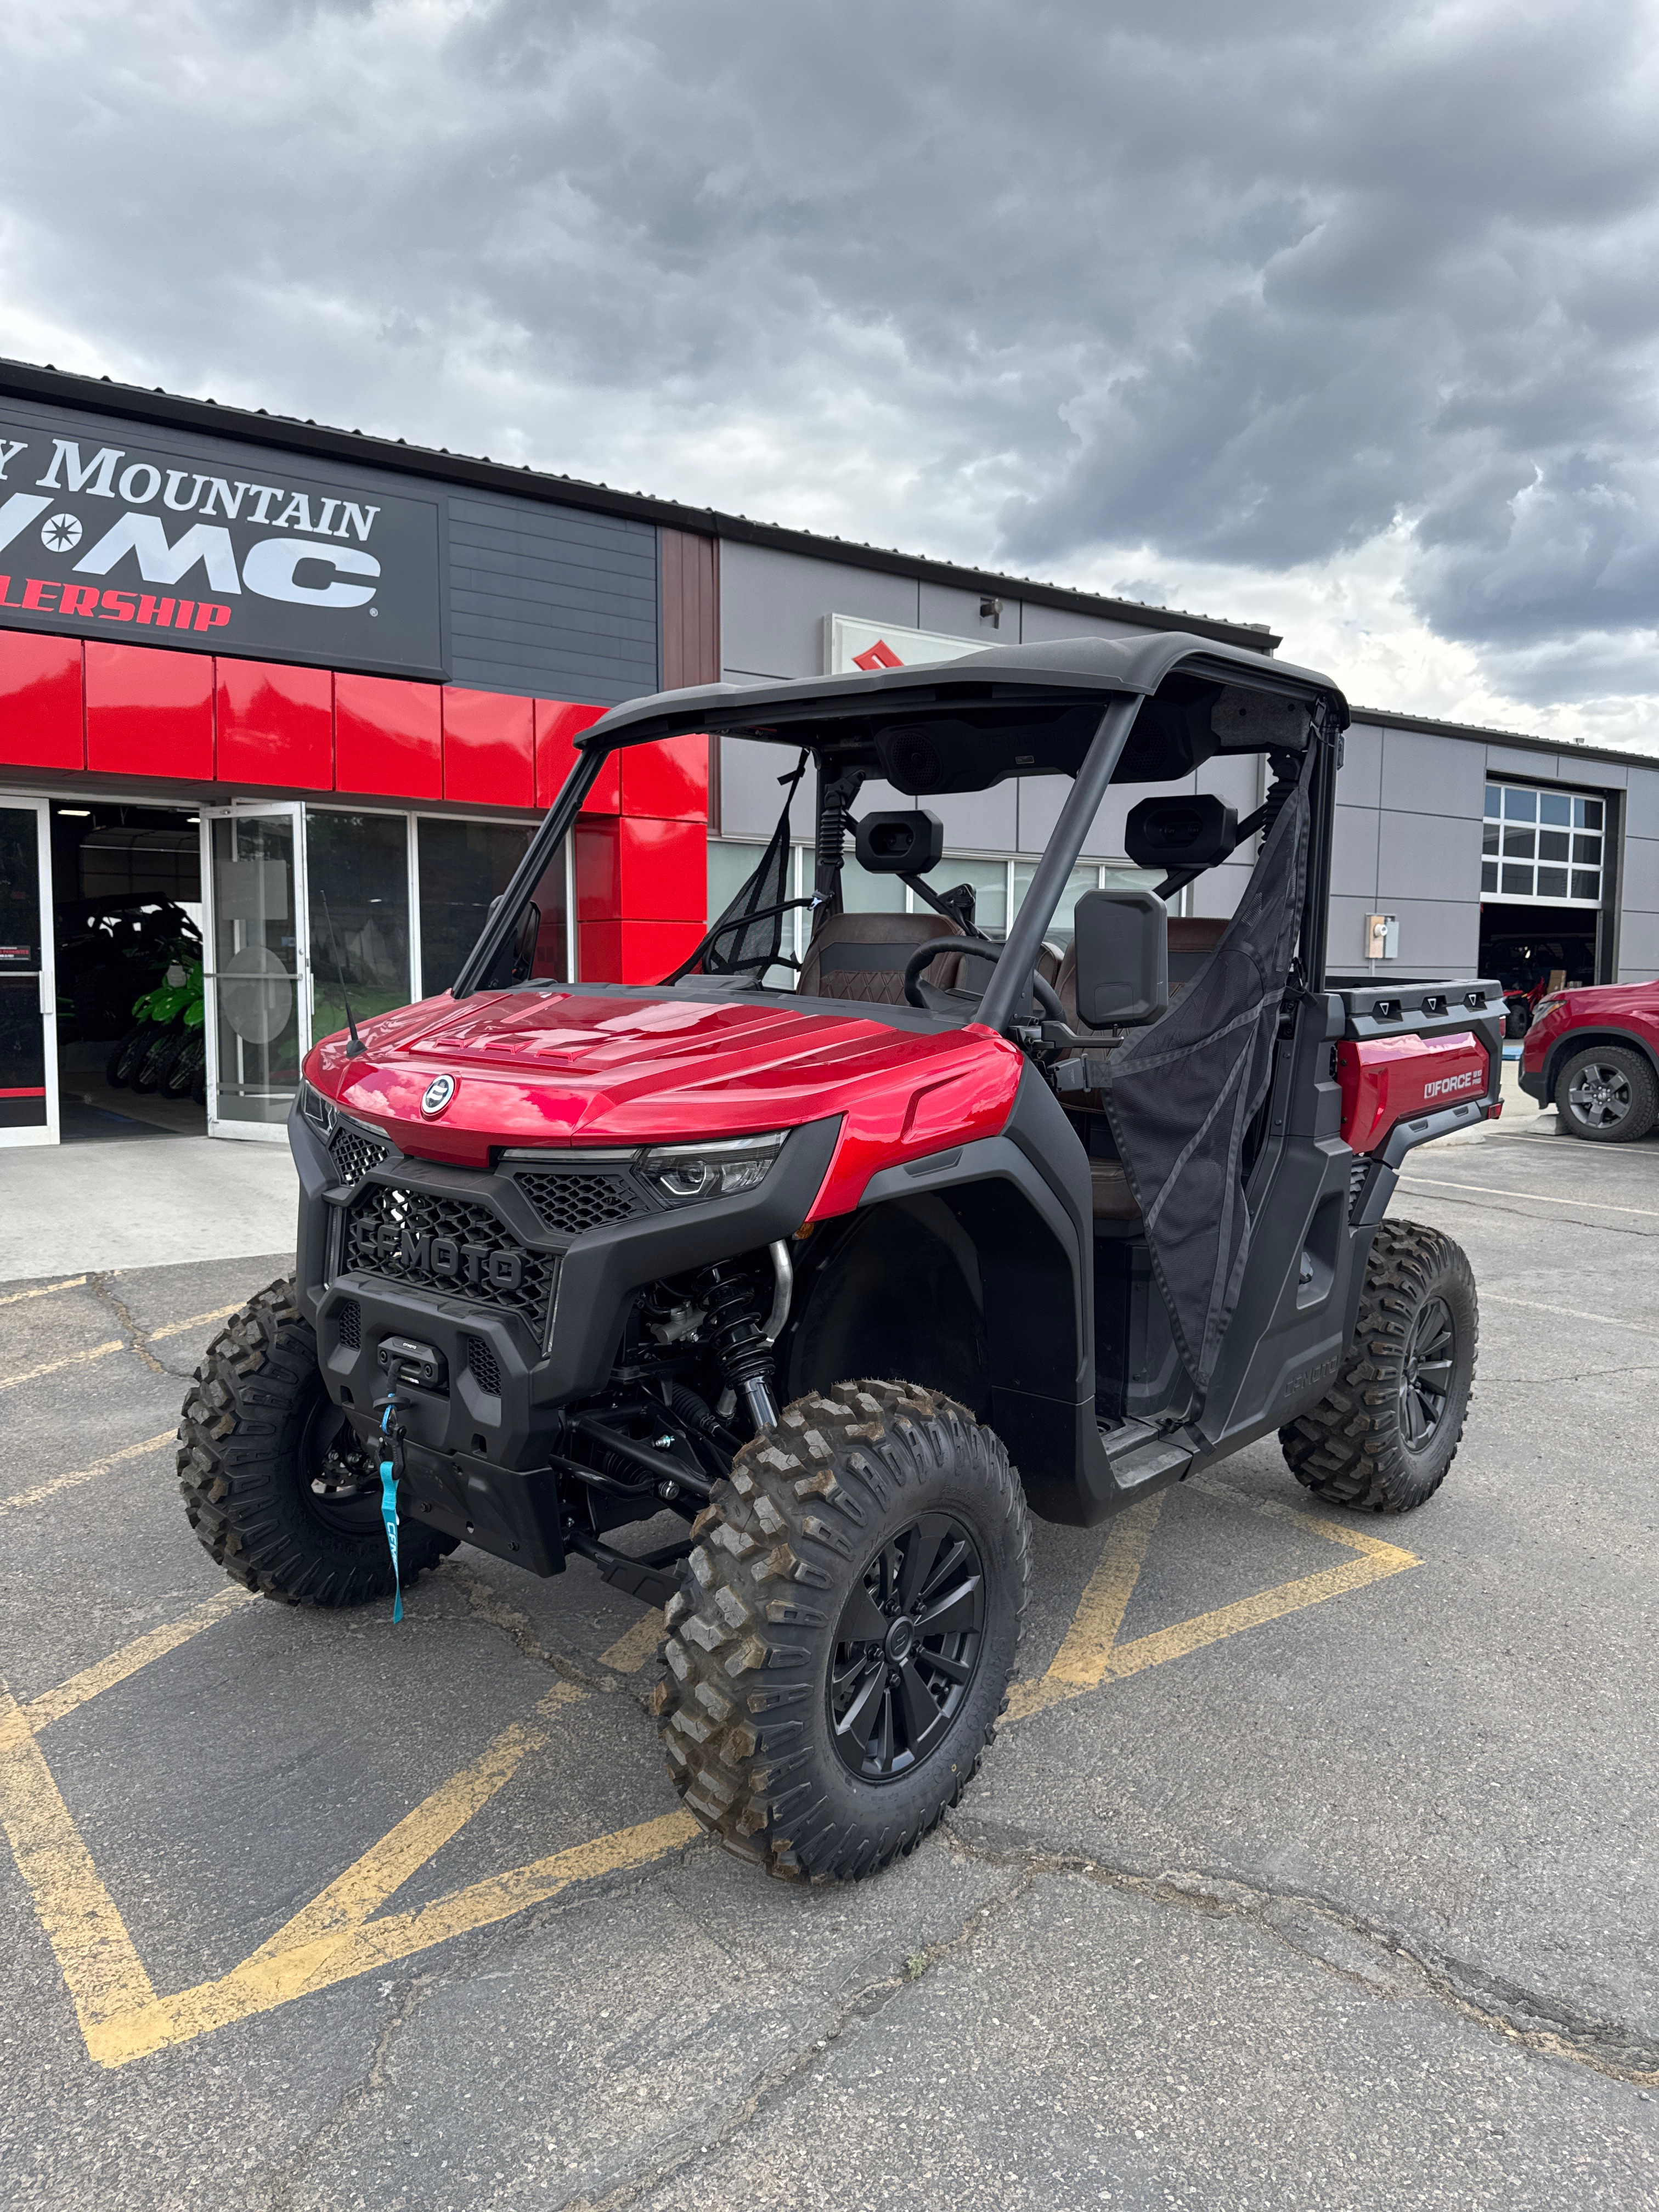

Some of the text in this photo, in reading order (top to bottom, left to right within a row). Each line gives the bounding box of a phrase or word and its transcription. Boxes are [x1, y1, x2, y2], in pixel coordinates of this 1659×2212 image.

[36, 438, 381, 541] MOUNTAIN
[1424, 1071, 1472, 1099] UFORCE
[357, 1218, 524, 1290] CFMOTO
[1284, 1355, 1339, 1397] CFMOTO
